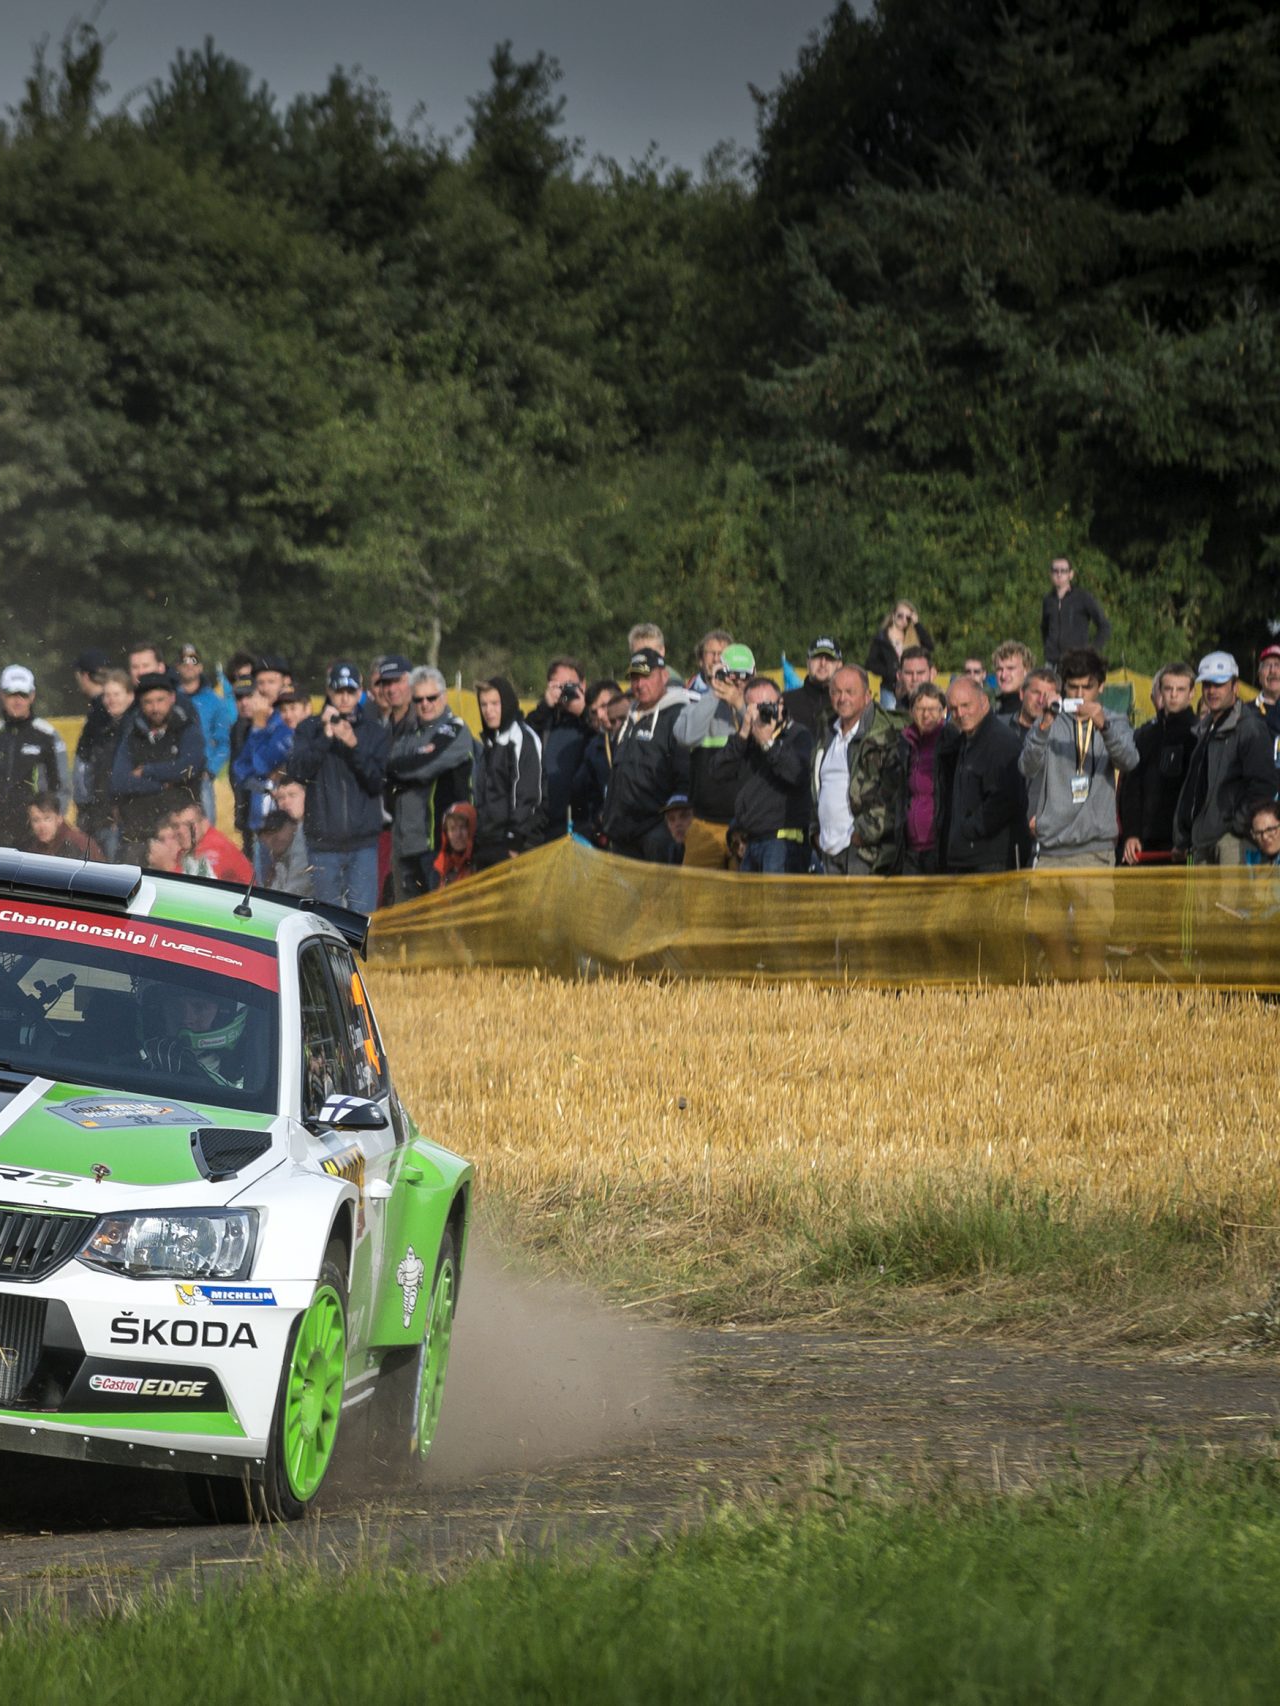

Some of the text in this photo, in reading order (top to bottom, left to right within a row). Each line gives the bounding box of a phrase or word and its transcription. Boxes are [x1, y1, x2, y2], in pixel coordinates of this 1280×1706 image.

[210, 1290, 273, 1300] MICHELIN
[110, 1311, 258, 1349] ŠKODA
[102, 1378, 209, 1397] Castrol EDGE
